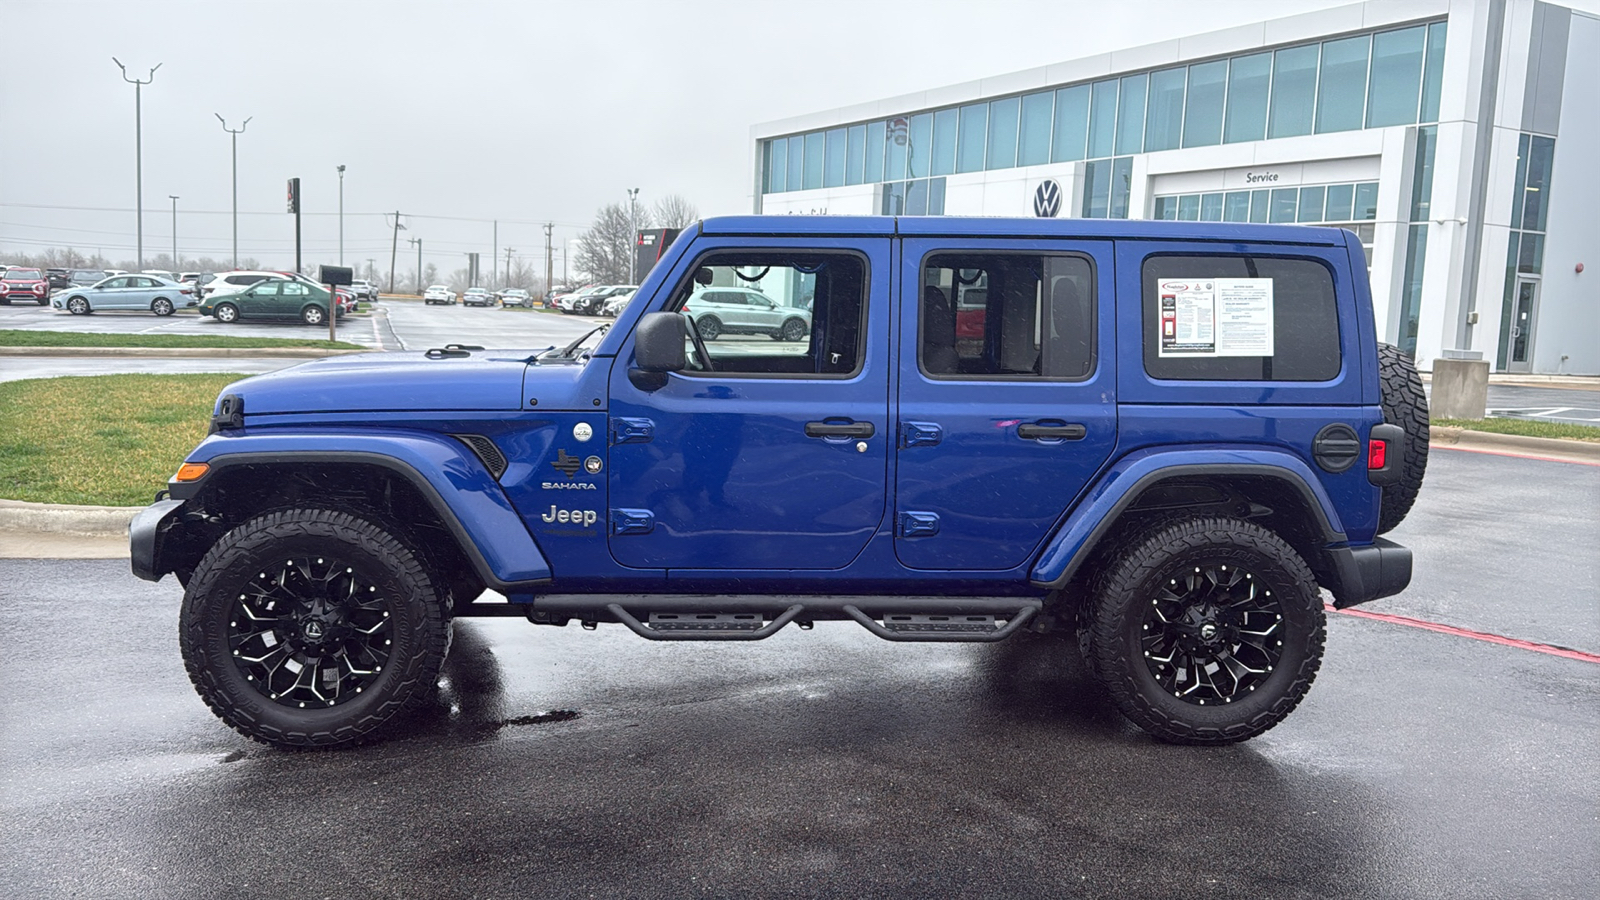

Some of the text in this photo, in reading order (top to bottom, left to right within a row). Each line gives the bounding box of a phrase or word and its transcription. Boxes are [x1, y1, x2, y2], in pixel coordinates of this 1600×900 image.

[1246, 172, 1279, 183] Service
[541, 482, 597, 490] SAHARA
[541, 504, 597, 528] Jeep
